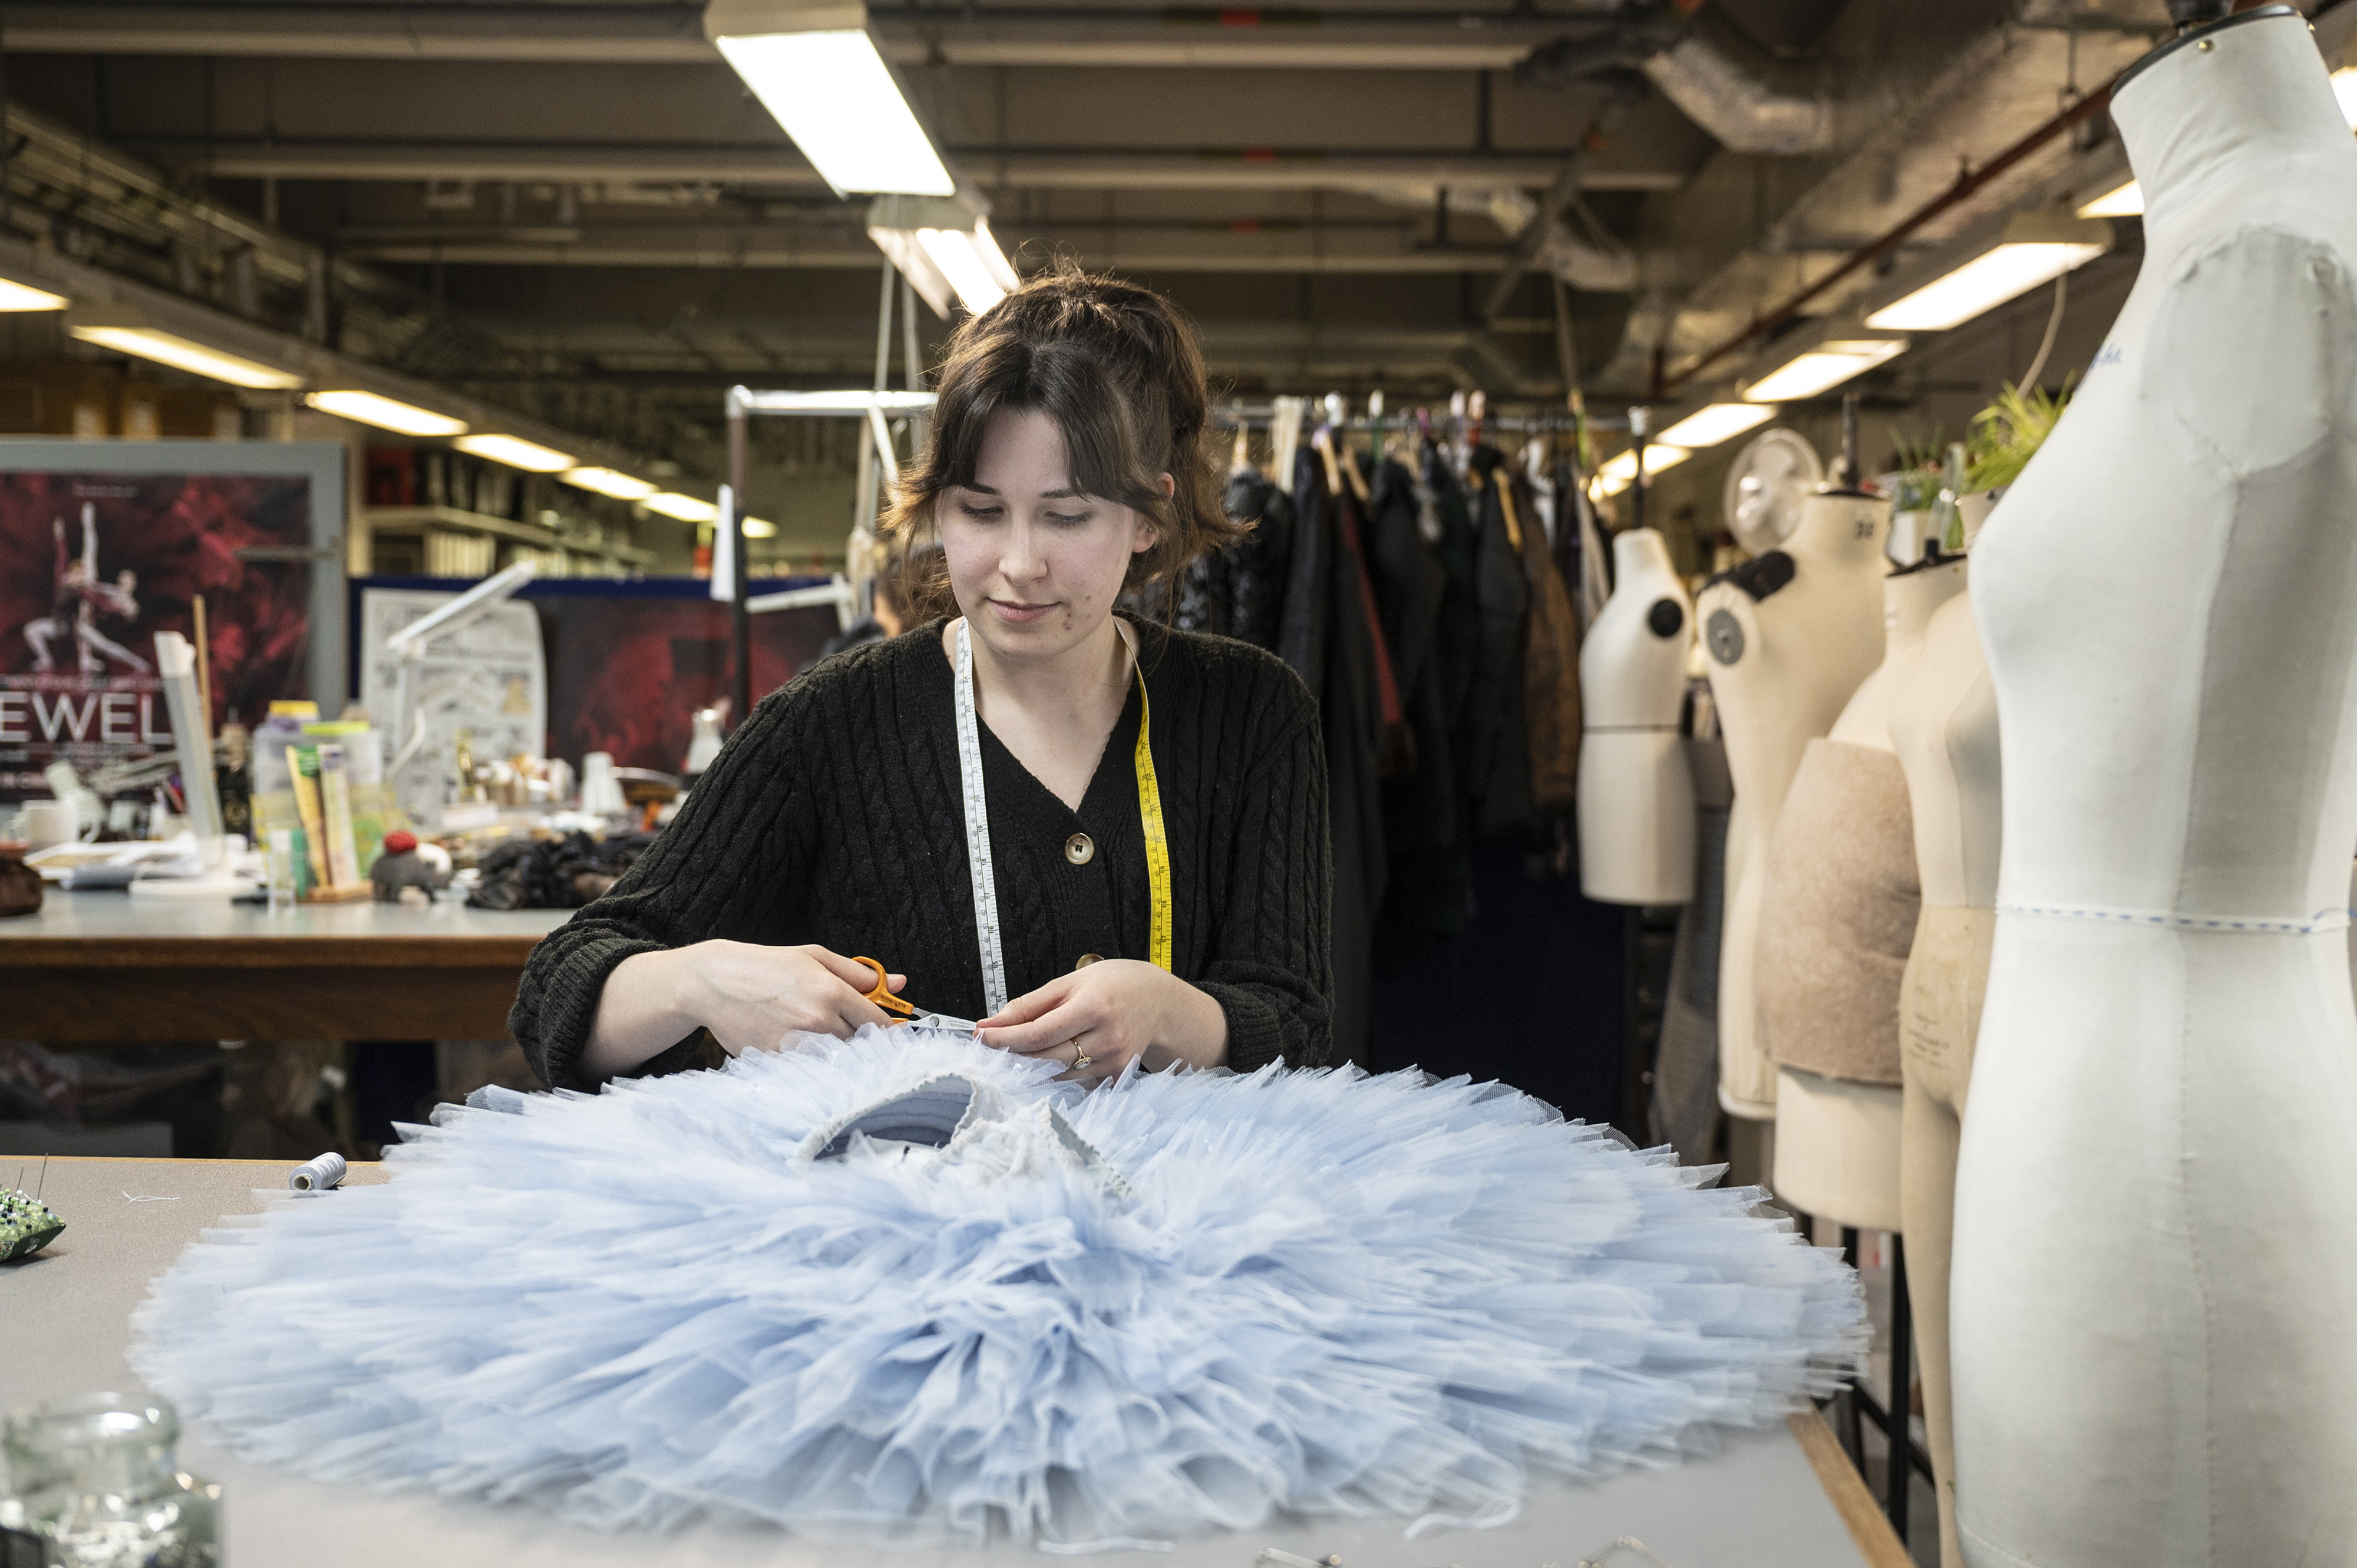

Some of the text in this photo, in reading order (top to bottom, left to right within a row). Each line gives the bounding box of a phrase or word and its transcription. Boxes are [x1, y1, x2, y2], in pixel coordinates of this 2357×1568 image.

[969, 735, 973, 743] 22
[975, 794, 980, 803] 20
[1151, 804, 1156, 812] 21
[982, 858, 986, 866] 18
[989, 925, 994, 934] 16
[993, 960, 998, 969] 15
